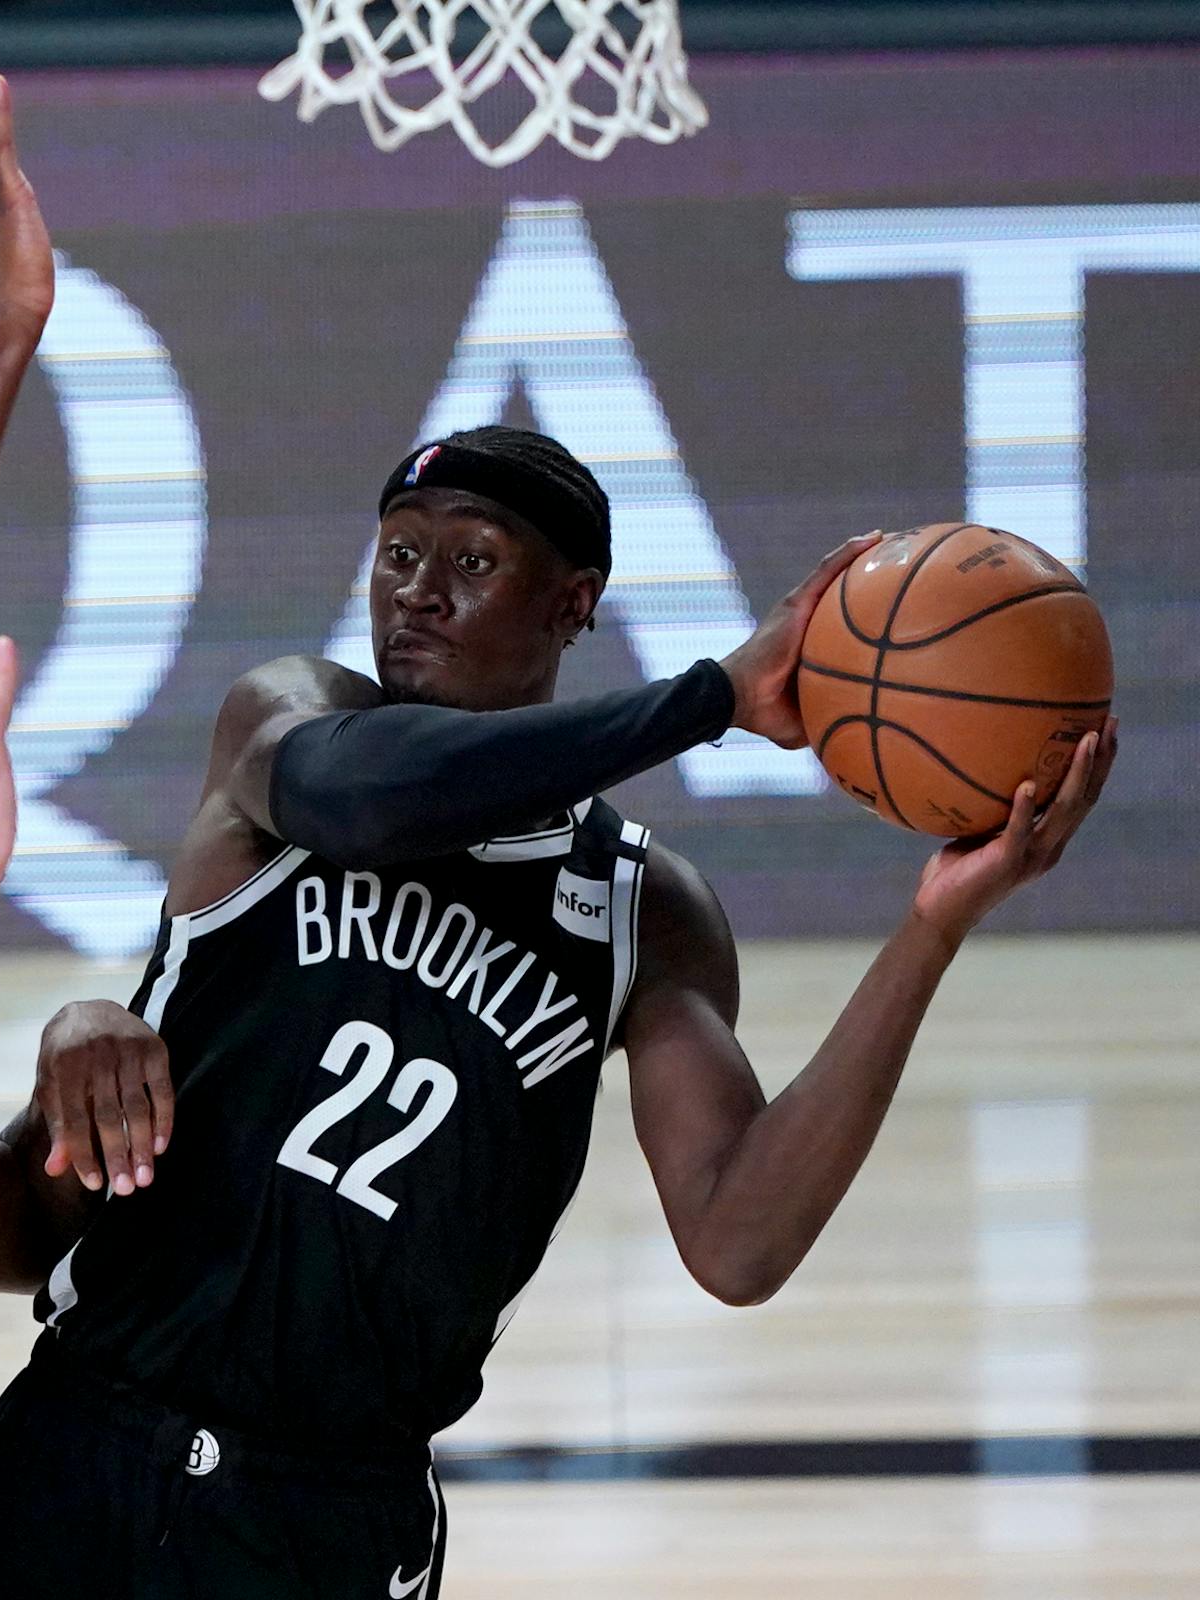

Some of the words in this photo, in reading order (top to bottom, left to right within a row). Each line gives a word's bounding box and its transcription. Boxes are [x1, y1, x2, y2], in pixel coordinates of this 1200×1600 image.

[297, 870, 595, 1090] BROOKLYN
[557, 881, 606, 918] infor
[276, 1020, 458, 1222] 22
